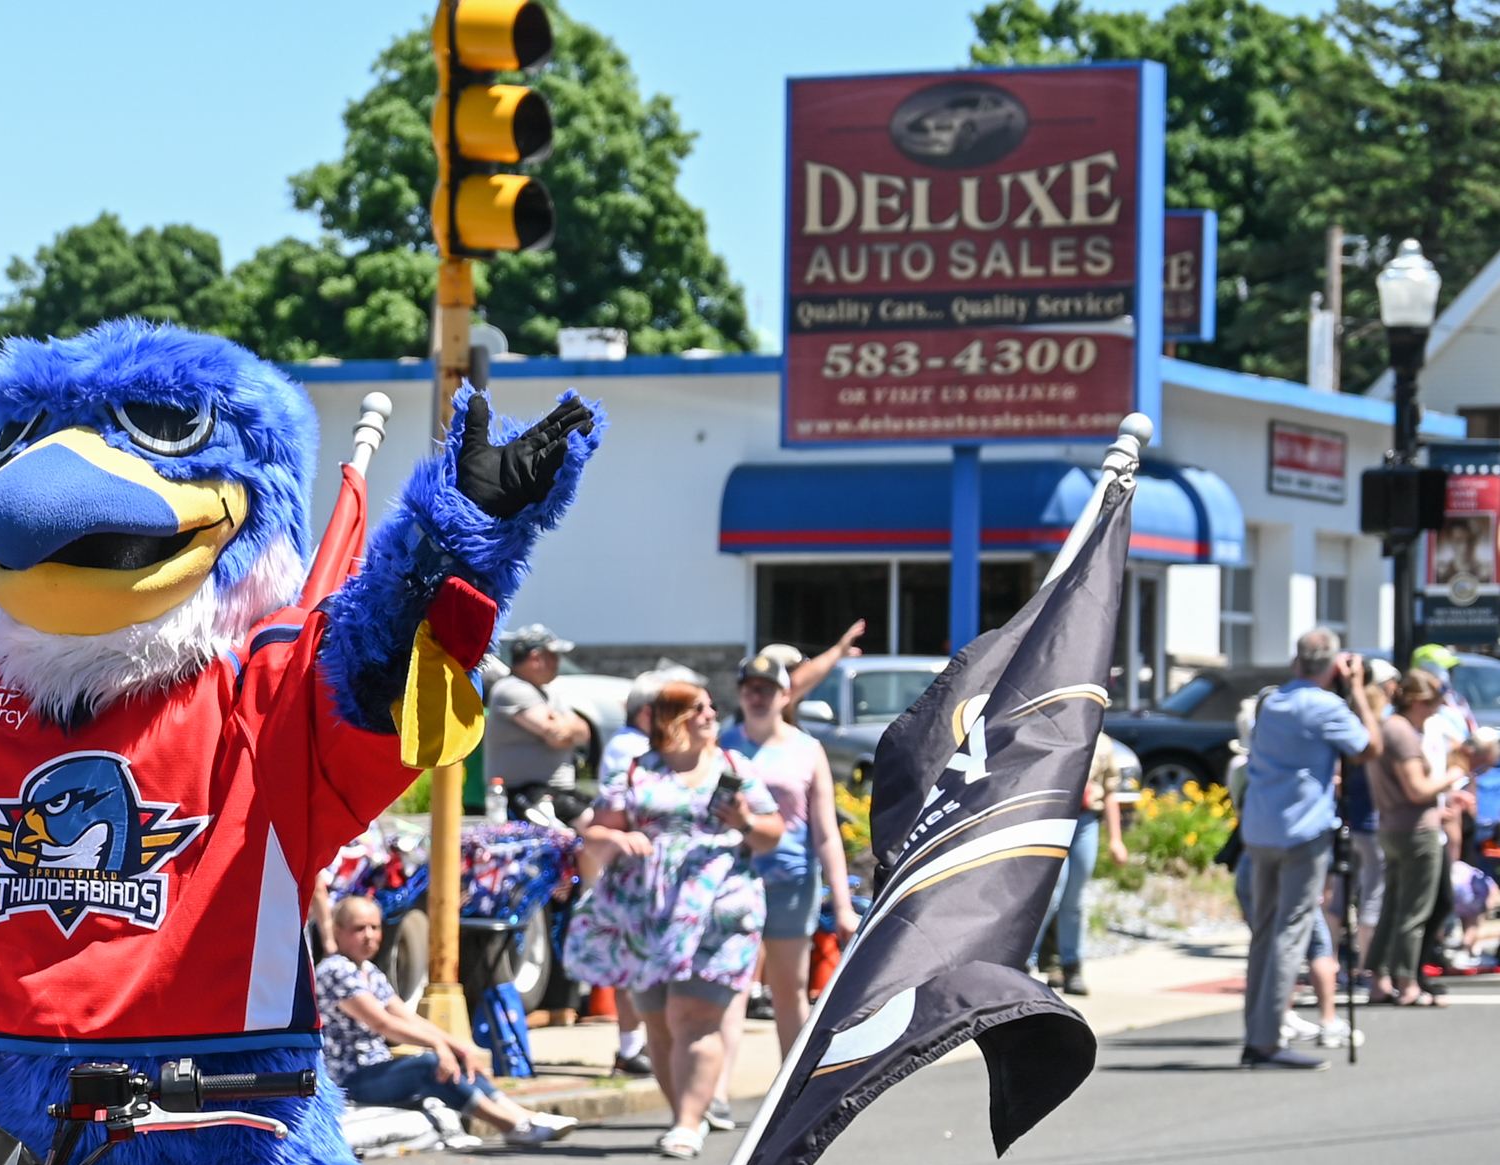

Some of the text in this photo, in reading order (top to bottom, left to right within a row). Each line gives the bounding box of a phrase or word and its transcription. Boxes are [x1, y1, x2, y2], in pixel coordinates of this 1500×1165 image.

[803, 151, 1122, 235] DELUXE
[804, 235, 1113, 285] AUTO SALES
[797, 291, 1125, 327] Quality Cars... Quality Service!
[821, 337, 1097, 378] 583-4300
[838, 387, 867, 405] OR
[874, 385, 934, 404] VISIT
[941, 384, 968, 404] US
[29, 867, 118, 881] SPRINGFIELD
